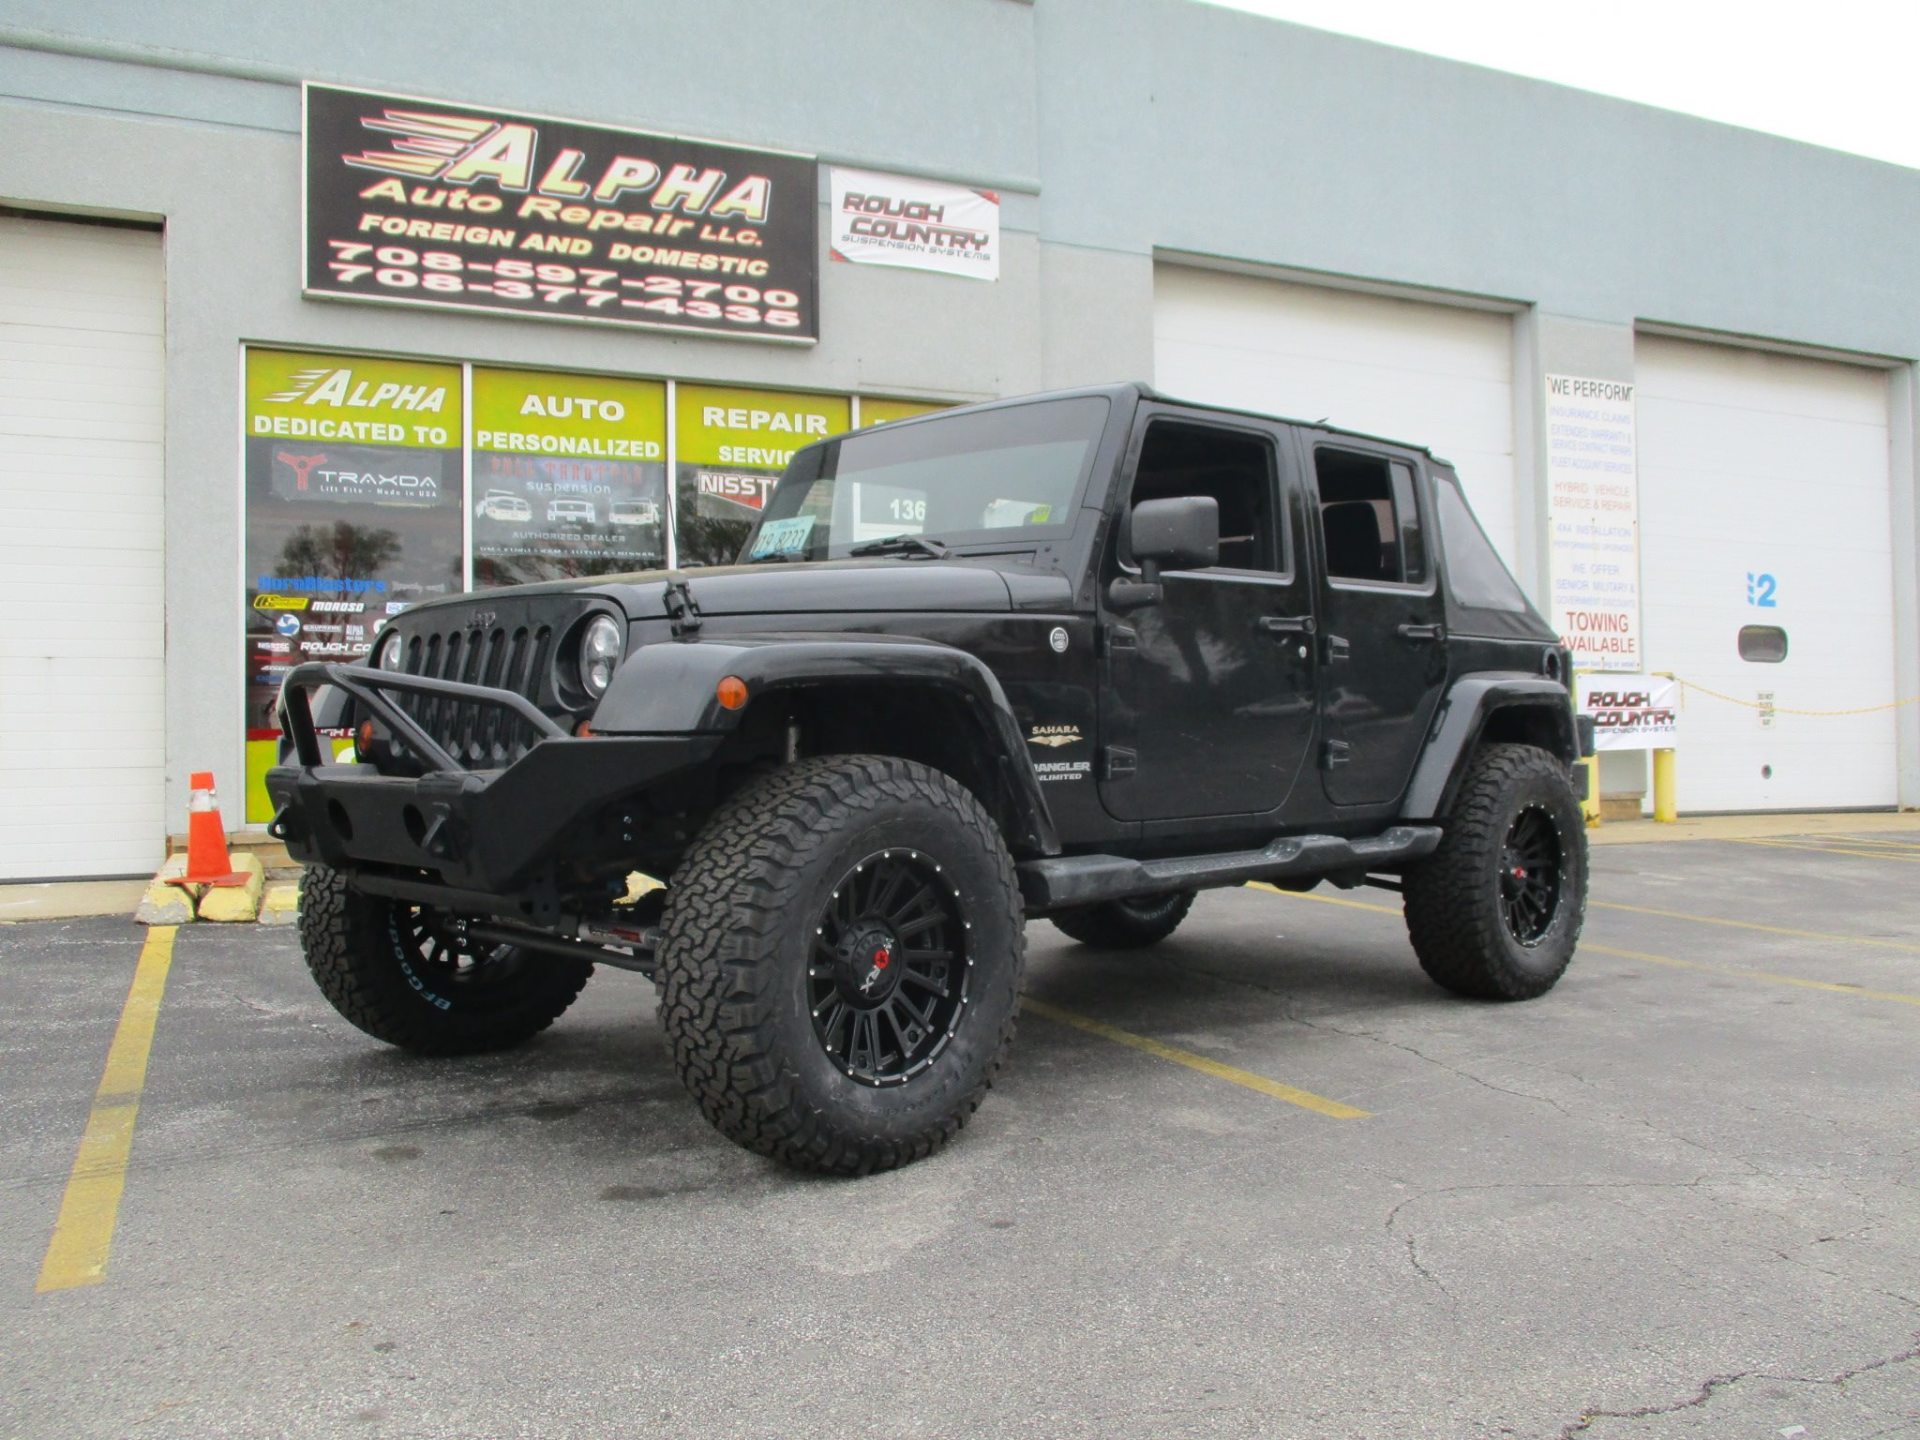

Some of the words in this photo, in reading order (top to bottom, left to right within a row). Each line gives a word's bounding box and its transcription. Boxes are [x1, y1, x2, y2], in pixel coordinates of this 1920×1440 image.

[444, 123, 771, 224] ALPHA
[359, 178, 503, 214] Auto
[518, 195, 696, 238] Repair
[843, 191, 945, 223] ROUGH
[358, 213, 516, 247] FOREIGN
[520, 231, 594, 257] AND
[609, 243, 770, 278] DOMESTIC
[850, 216, 990, 251] COUNTRY
[841, 234, 926, 253] SUSPENSION
[928, 246, 991, 261] SYSTEMS
[328, 240, 800, 309] 708-597-2700
[328, 262, 800, 328] 708-377-4335
[305, 368, 448, 413] ALPHA
[1551, 378, 1570, 396] WE
[1574, 380, 1632, 401] PERFORM
[520, 394, 625, 422] AUTO
[703, 406, 828, 434] REPAIR
[254, 415, 405, 443] DEDICATED
[413, 425, 448, 445] TO
[477, 431, 660, 459] PERSONALIZED
[718, 445, 795, 465] SERVIC
[317, 470, 438, 489] TRAXDA
[526, 481, 612, 496] suspension
[700, 474, 779, 508] NISST
[890, 500, 926, 521] 136
[512, 531, 580, 543] AUTHORIZED
[584, 533, 627, 544] DEALER
[311, 601, 365, 613] MOROSO
[1566, 611, 1629, 633] TOWING
[300, 642, 348, 651] ROUGH
[352, 643, 371, 652] CO
[1559, 636, 1635, 653] AVAILABLE
[1587, 692, 1651, 707] ROUGH
[1032, 725, 1080, 735] SAHARA
[1593, 710, 1675, 727] COUNTRY
[1033, 761, 1091, 772] ANGLER
